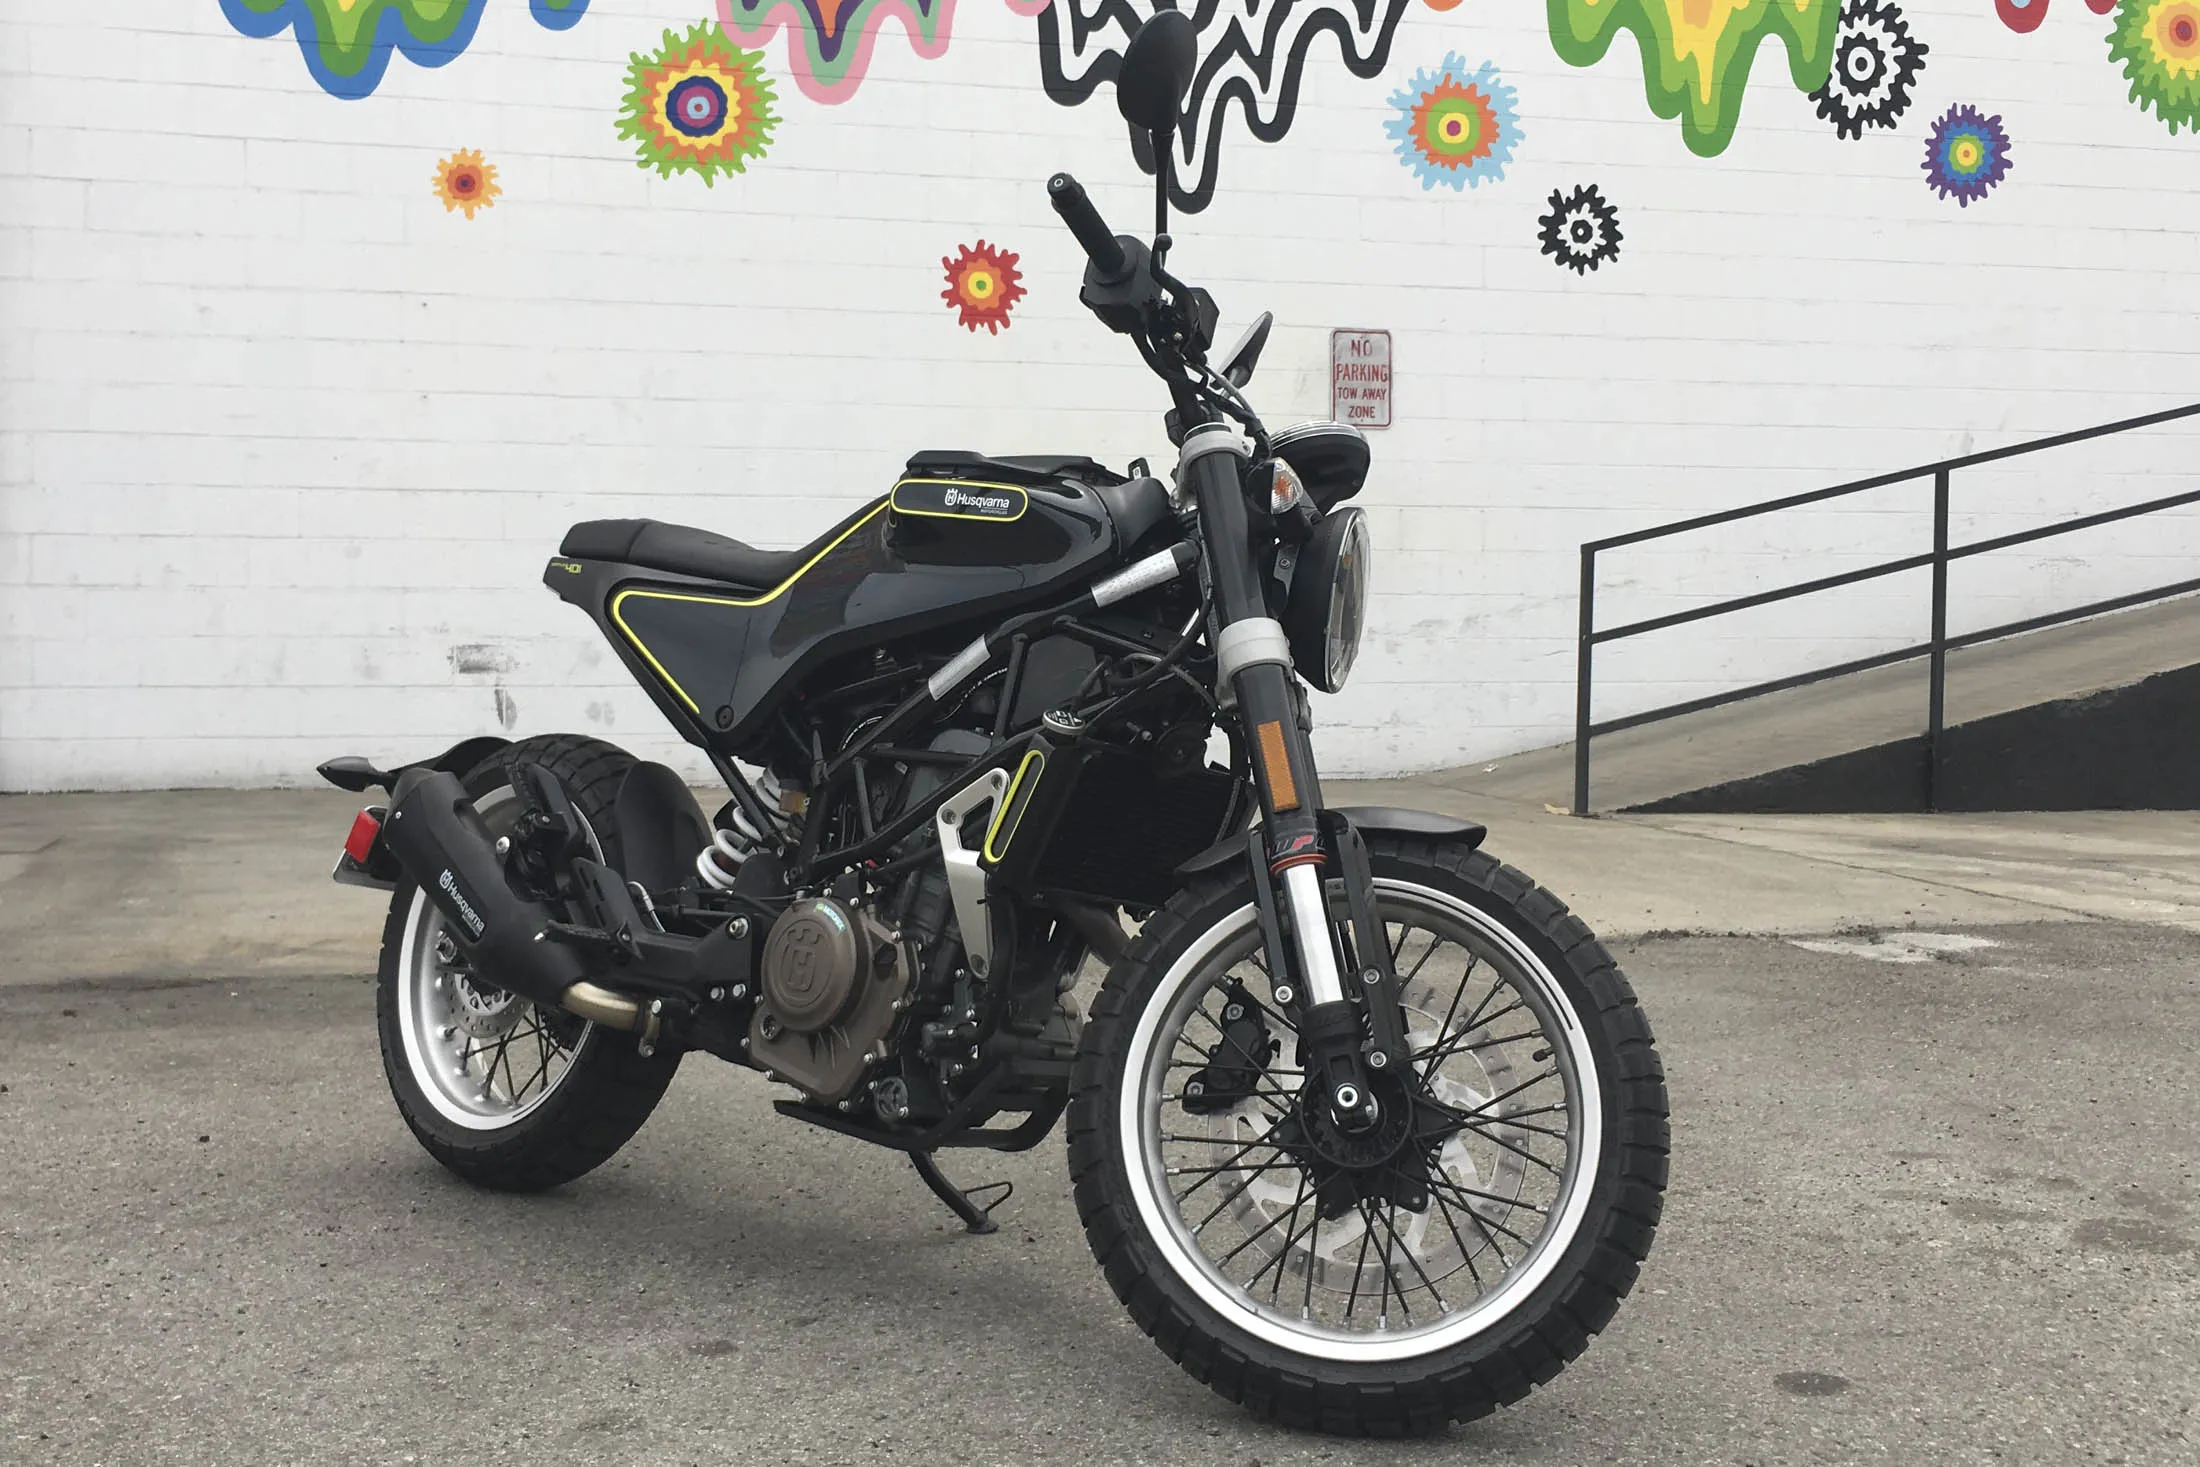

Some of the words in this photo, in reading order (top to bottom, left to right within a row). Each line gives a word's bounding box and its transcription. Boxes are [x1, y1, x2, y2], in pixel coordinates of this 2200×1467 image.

[1351, 340, 1373, 357] NO
[1336, 363, 1388, 382] PARKING
[1337, 387, 1358, 400] TOW
[1362, 387, 1387, 400] AWAY
[1348, 405, 1376, 419] ZONE
[957, 493, 1010, 509] Husqvarna
[447, 882, 485, 932] Husqvarna
